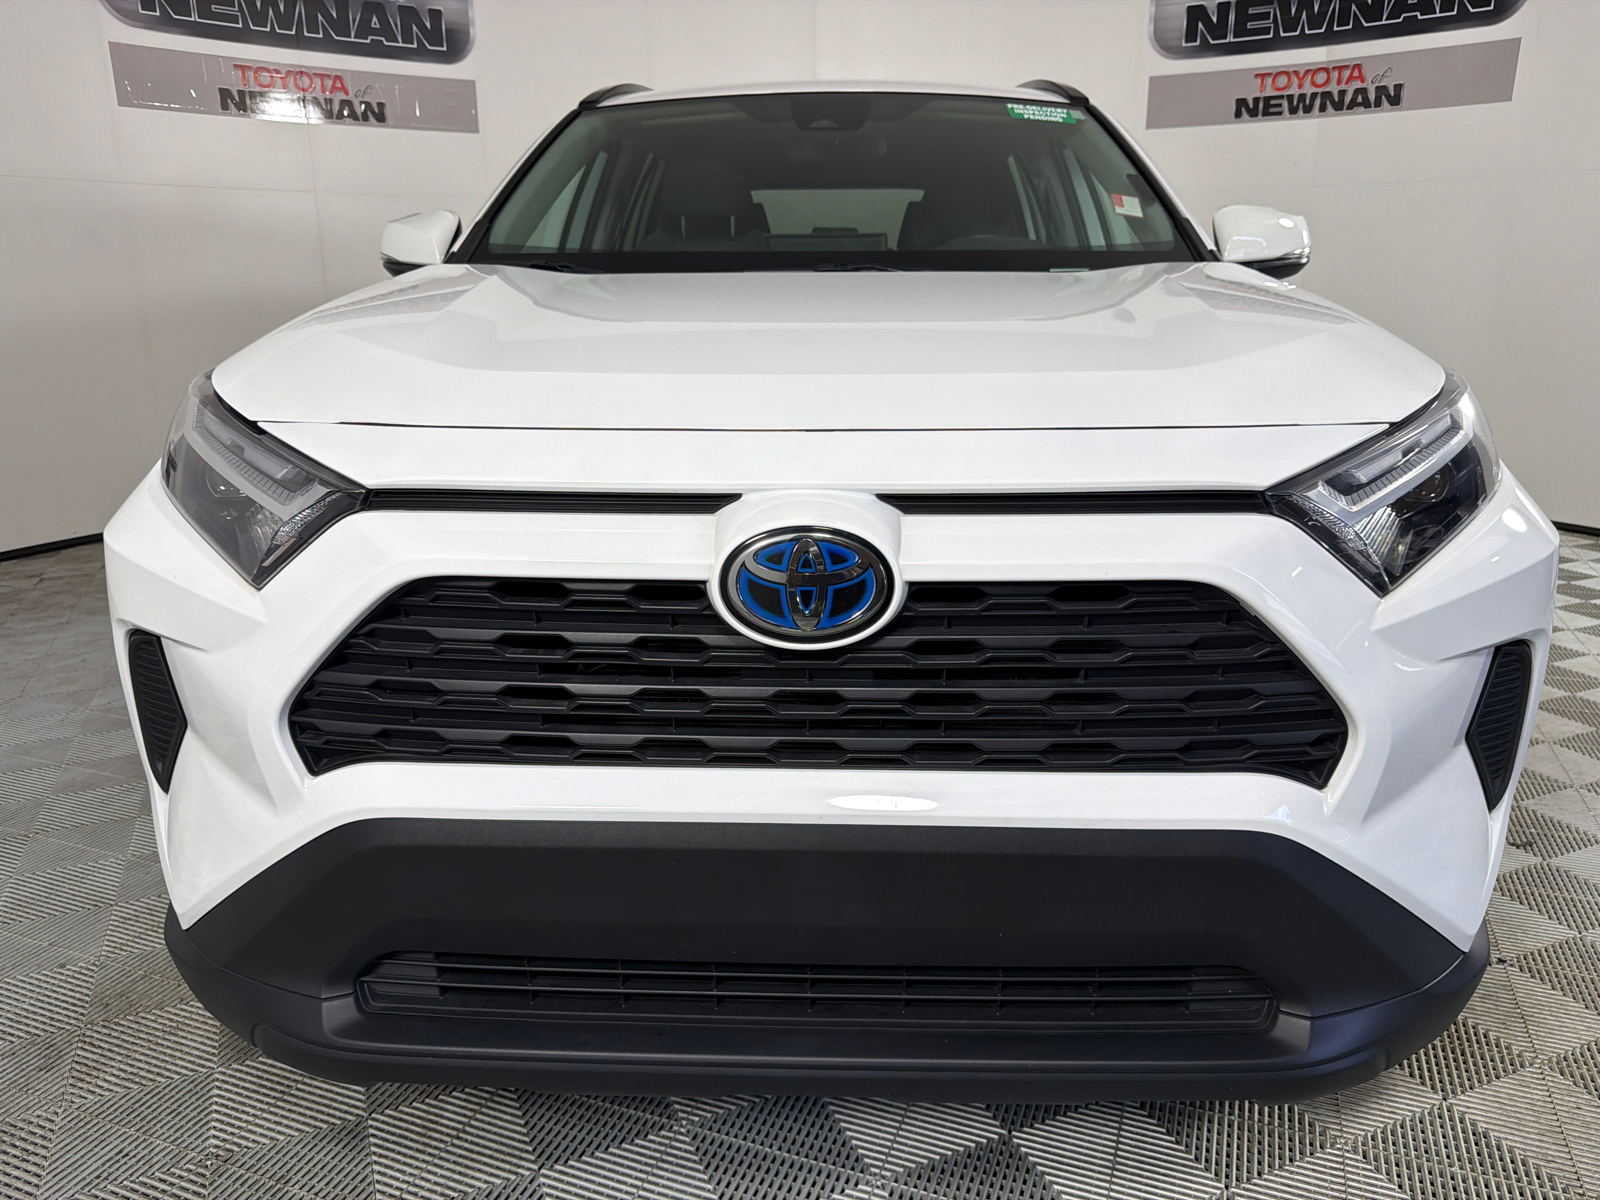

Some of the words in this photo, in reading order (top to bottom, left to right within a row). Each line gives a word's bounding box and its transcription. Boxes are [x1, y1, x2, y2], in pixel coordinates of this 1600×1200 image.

[233, 64, 349, 96] TOYOTA
[354, 84, 373, 99] of
[1255, 63, 1366, 93] TOYOTA
[1370, 66, 1393, 84] of
[218, 88, 386, 123] NNAN
[1023, 114, 1063, 122] PENDING
[1234, 83, 1403, 118] NEWNAN
